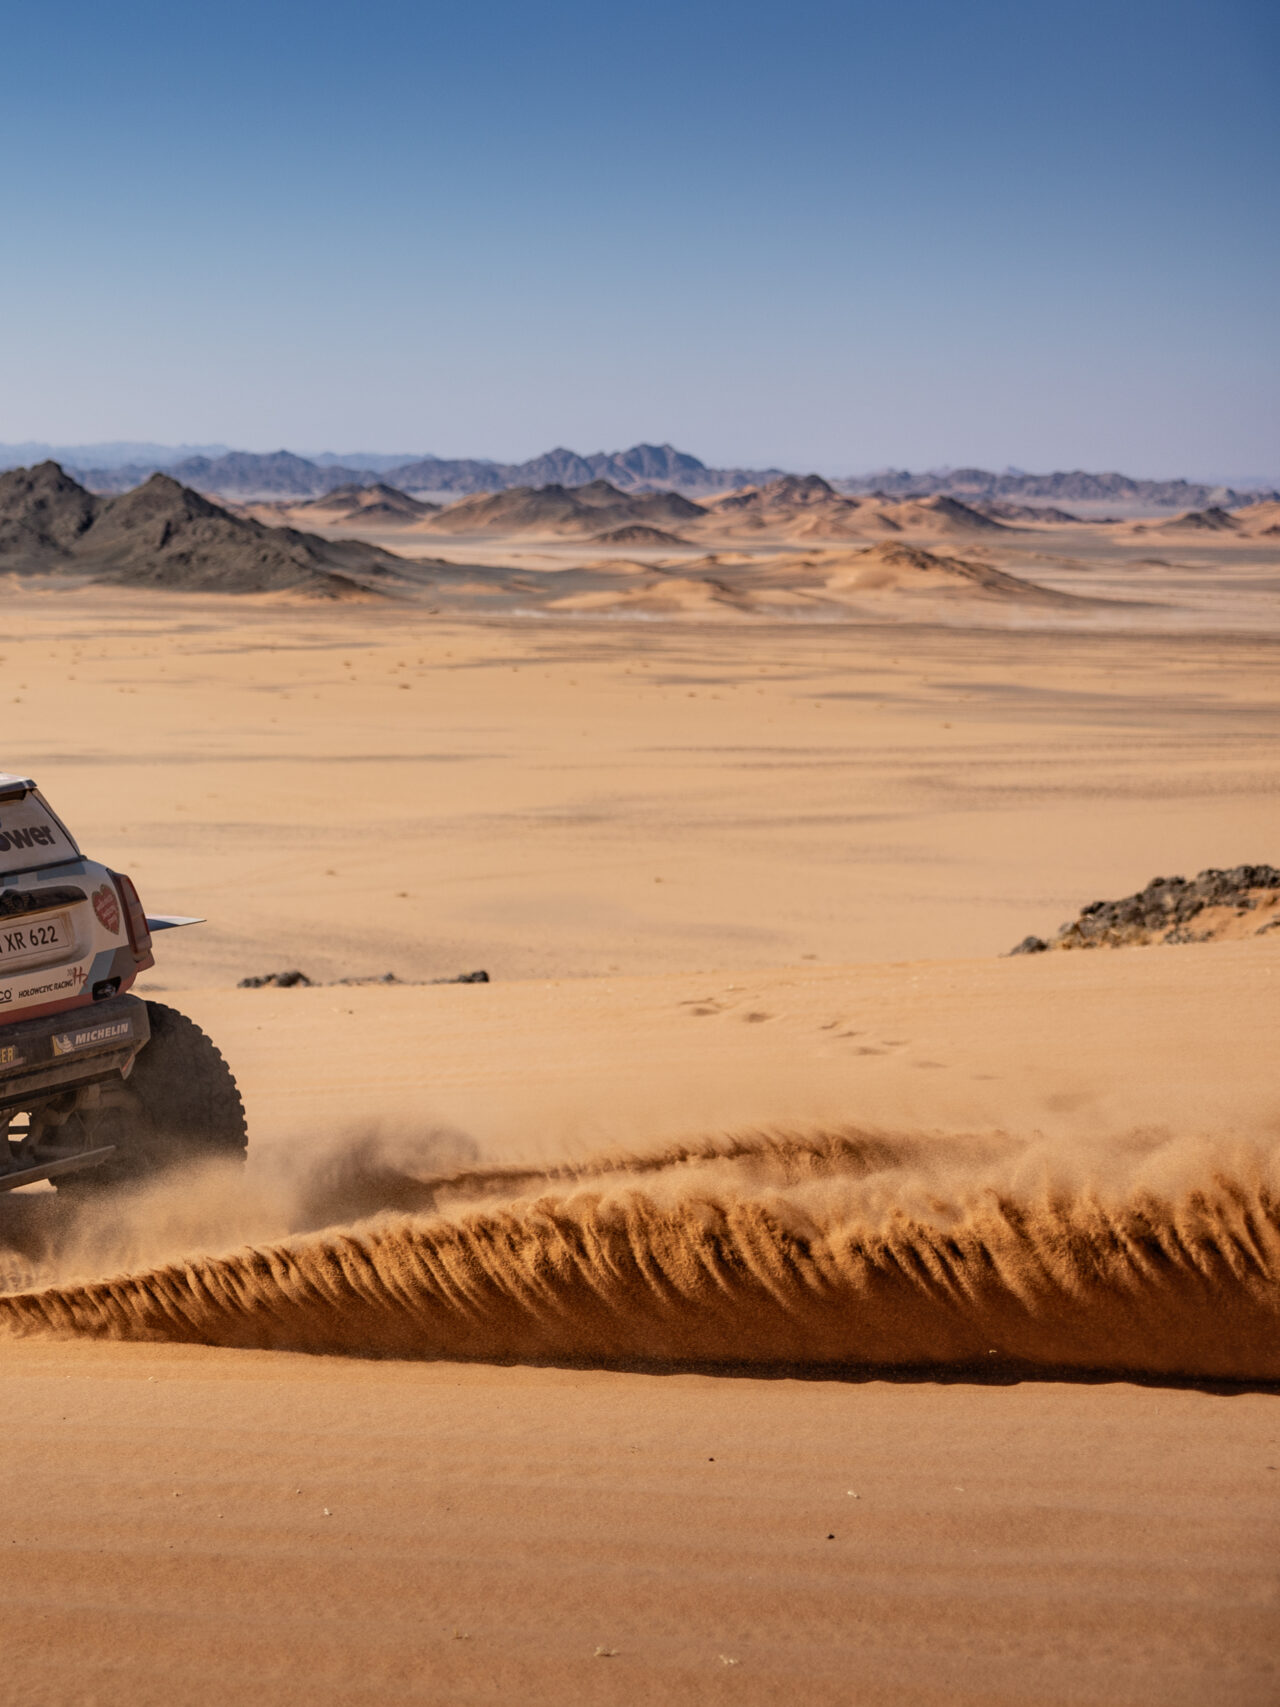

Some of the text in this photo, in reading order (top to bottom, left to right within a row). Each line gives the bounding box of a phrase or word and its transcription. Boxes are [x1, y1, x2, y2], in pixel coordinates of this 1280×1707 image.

[4, 931, 27, 952] XR
[29, 925, 59, 947] 622
[75, 1023, 129, 1045] MICHELIN
